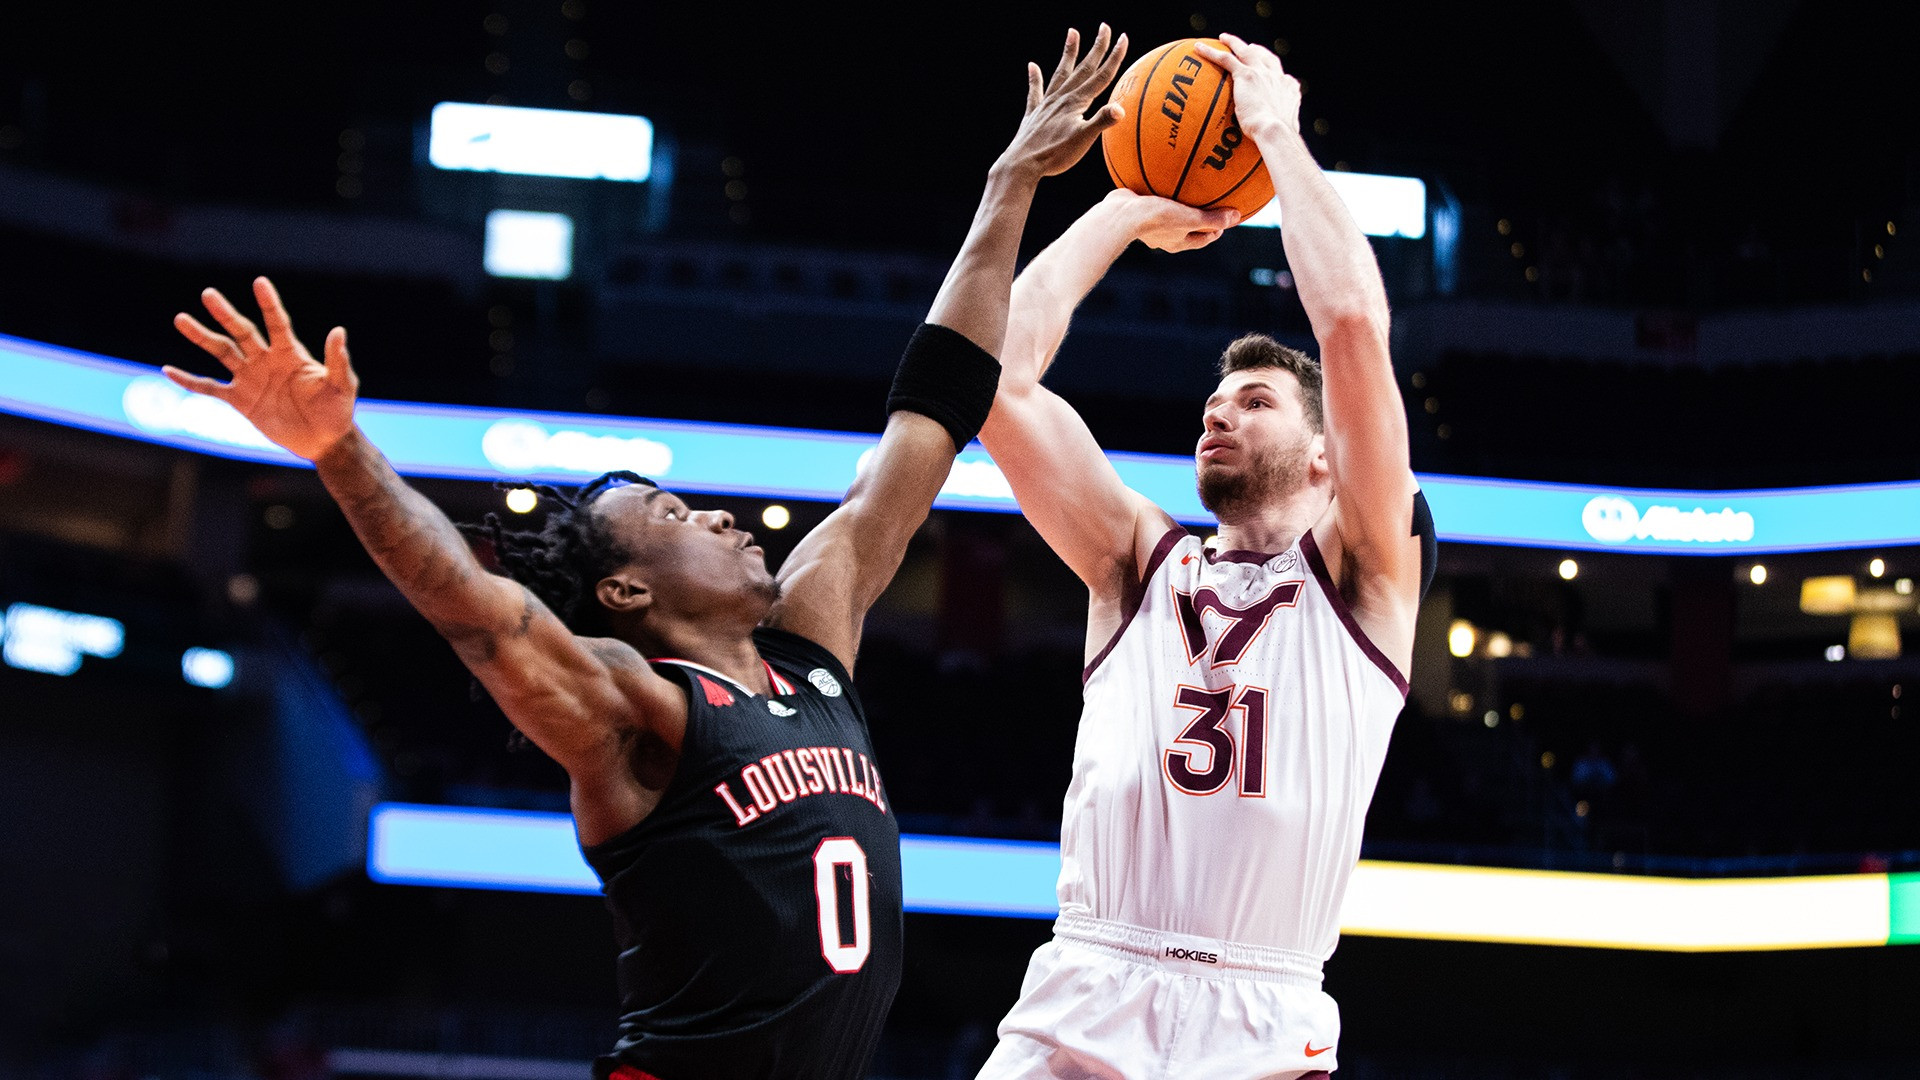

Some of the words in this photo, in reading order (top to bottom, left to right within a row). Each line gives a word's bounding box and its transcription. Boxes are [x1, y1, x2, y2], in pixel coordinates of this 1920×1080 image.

[1161, 54, 1203, 124] EVO
[1168, 123, 1180, 150] NXT
[817, 674, 834, 687] ACC
[1163, 684, 1269, 798] 31
[714, 747, 887, 827] LOUISVILLE
[812, 836, 871, 974] 0
[1165, 946, 1218, 964] HOKIES
